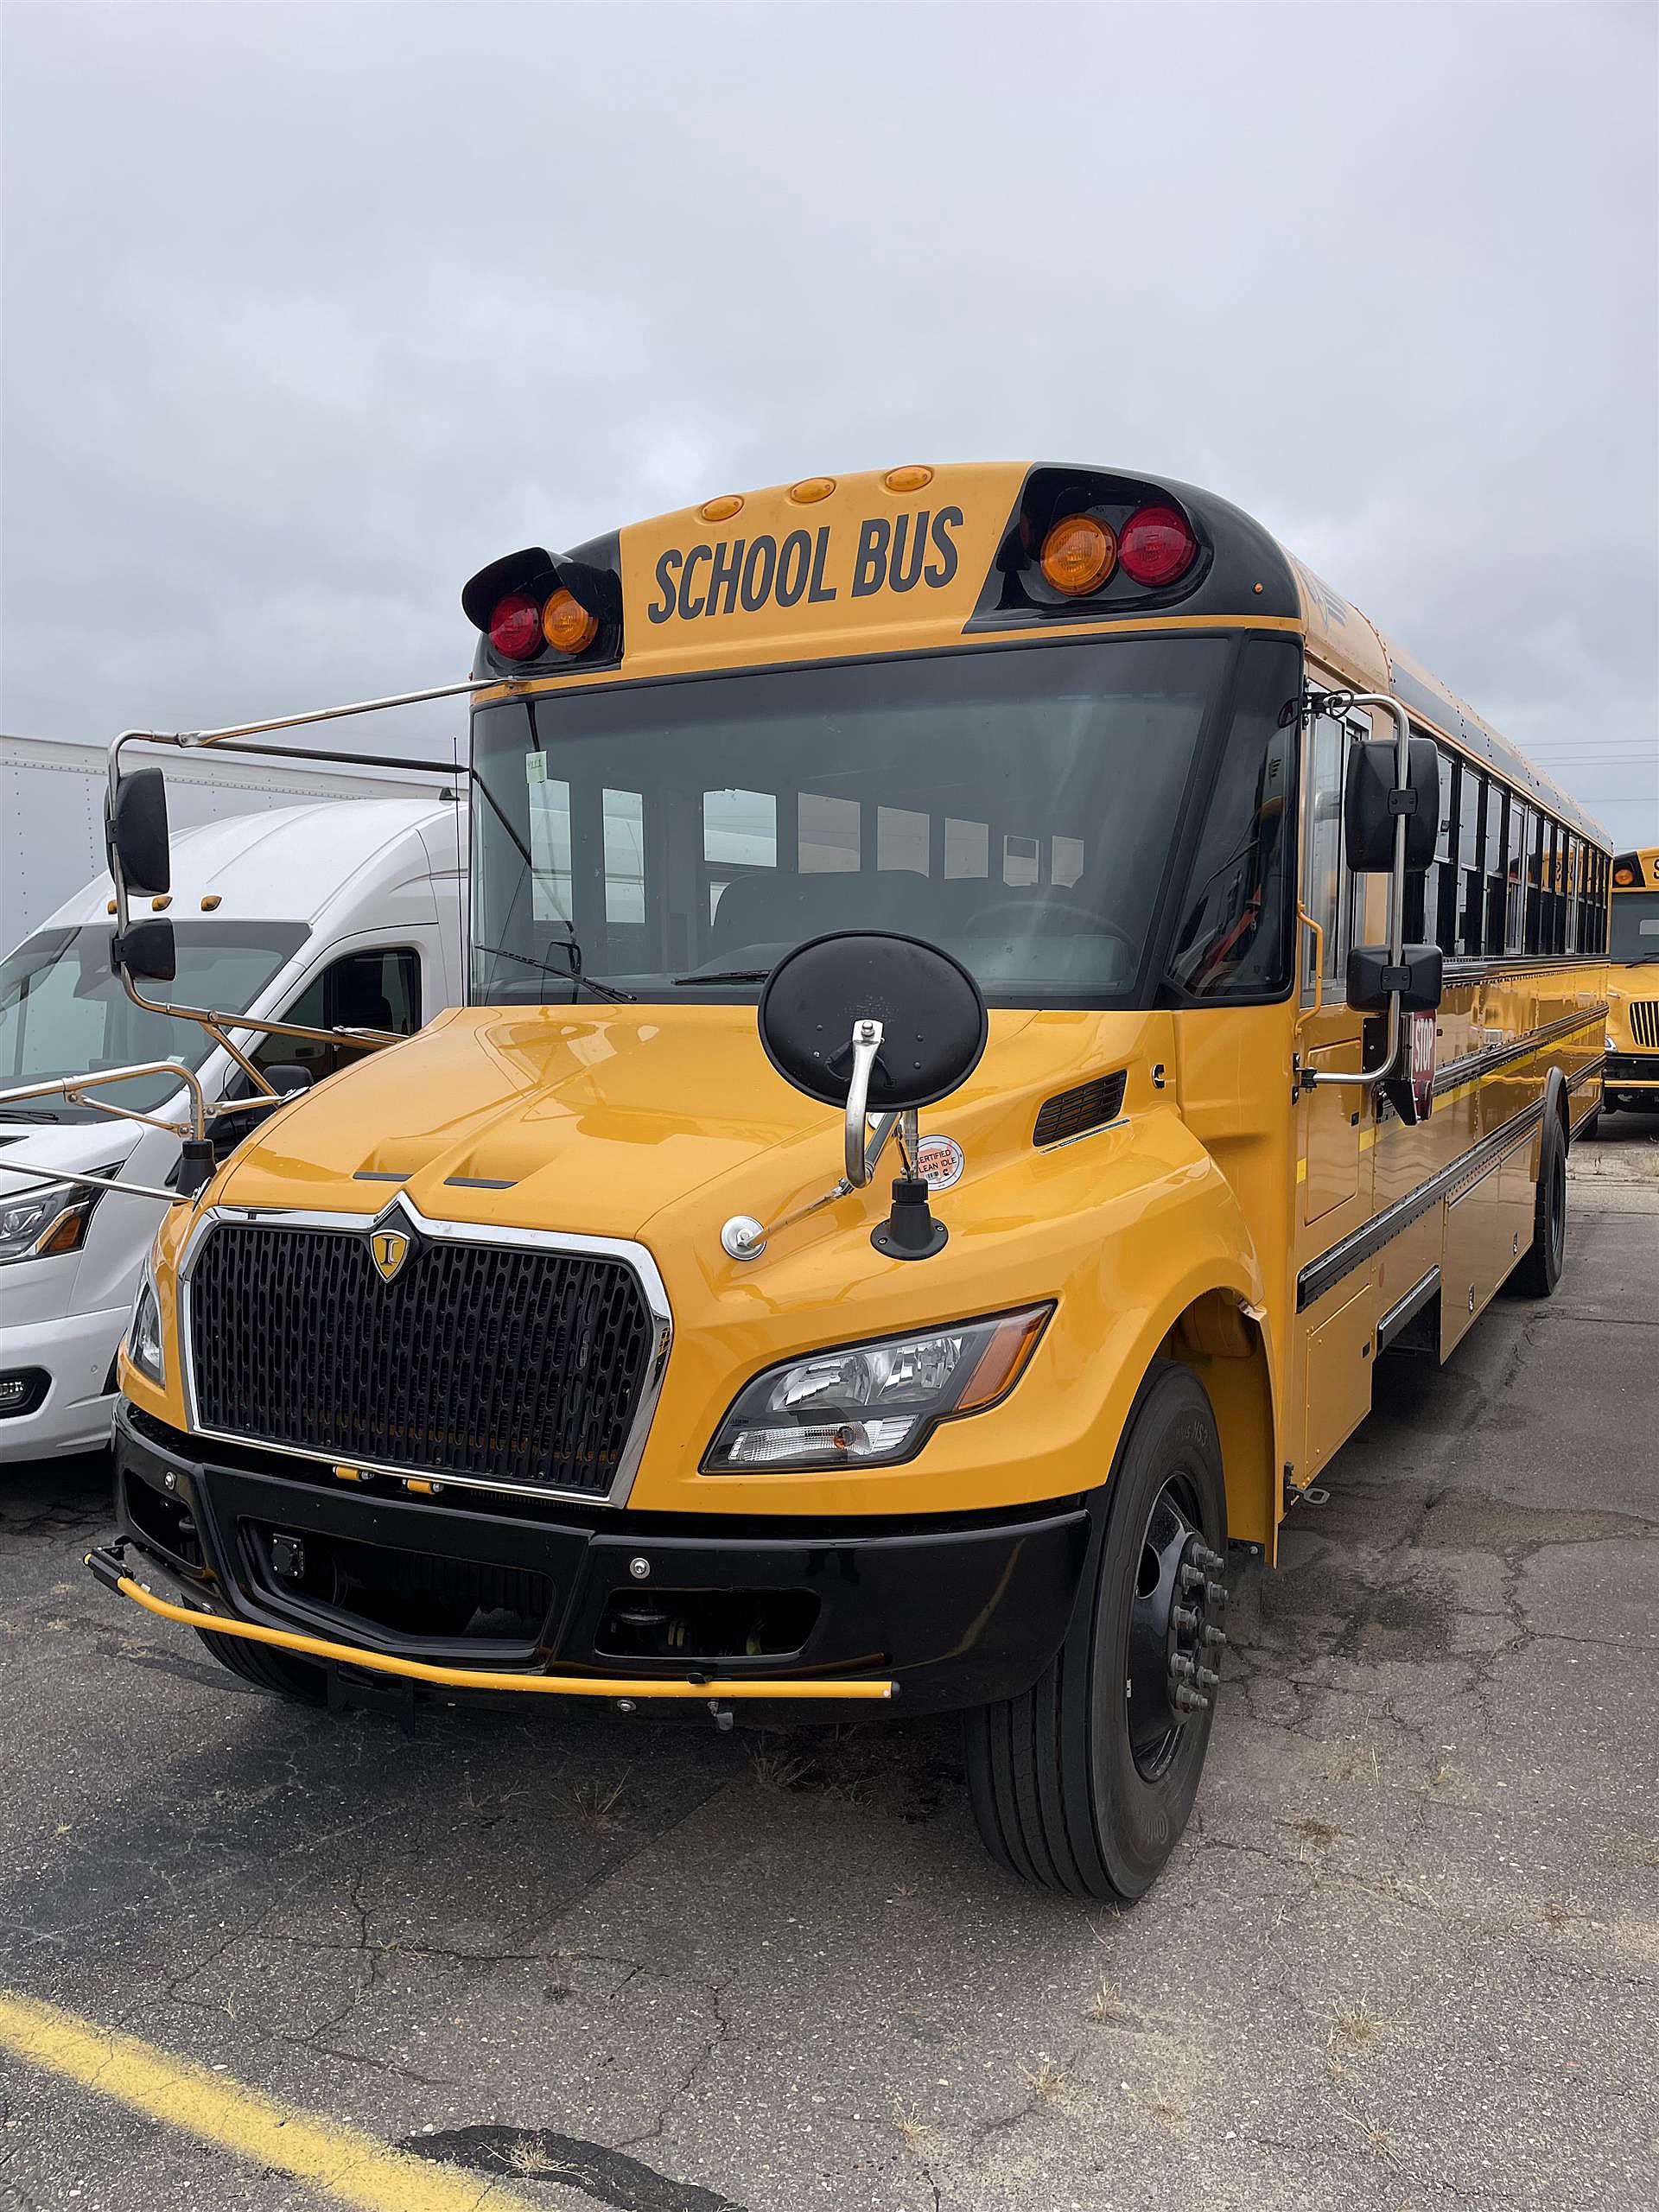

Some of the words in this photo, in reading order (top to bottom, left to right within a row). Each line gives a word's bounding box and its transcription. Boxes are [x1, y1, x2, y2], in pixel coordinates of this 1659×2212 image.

[647, 525, 837, 625] SCHOOL
[851, 505, 964, 598] BUS
[1415, 1018, 1433, 1072] STOP
[918, 1149, 951, 1165] ERTIFIED
[918, 1162, 939, 1173] LEAN
[941, 1157, 957, 1167] IDLE
